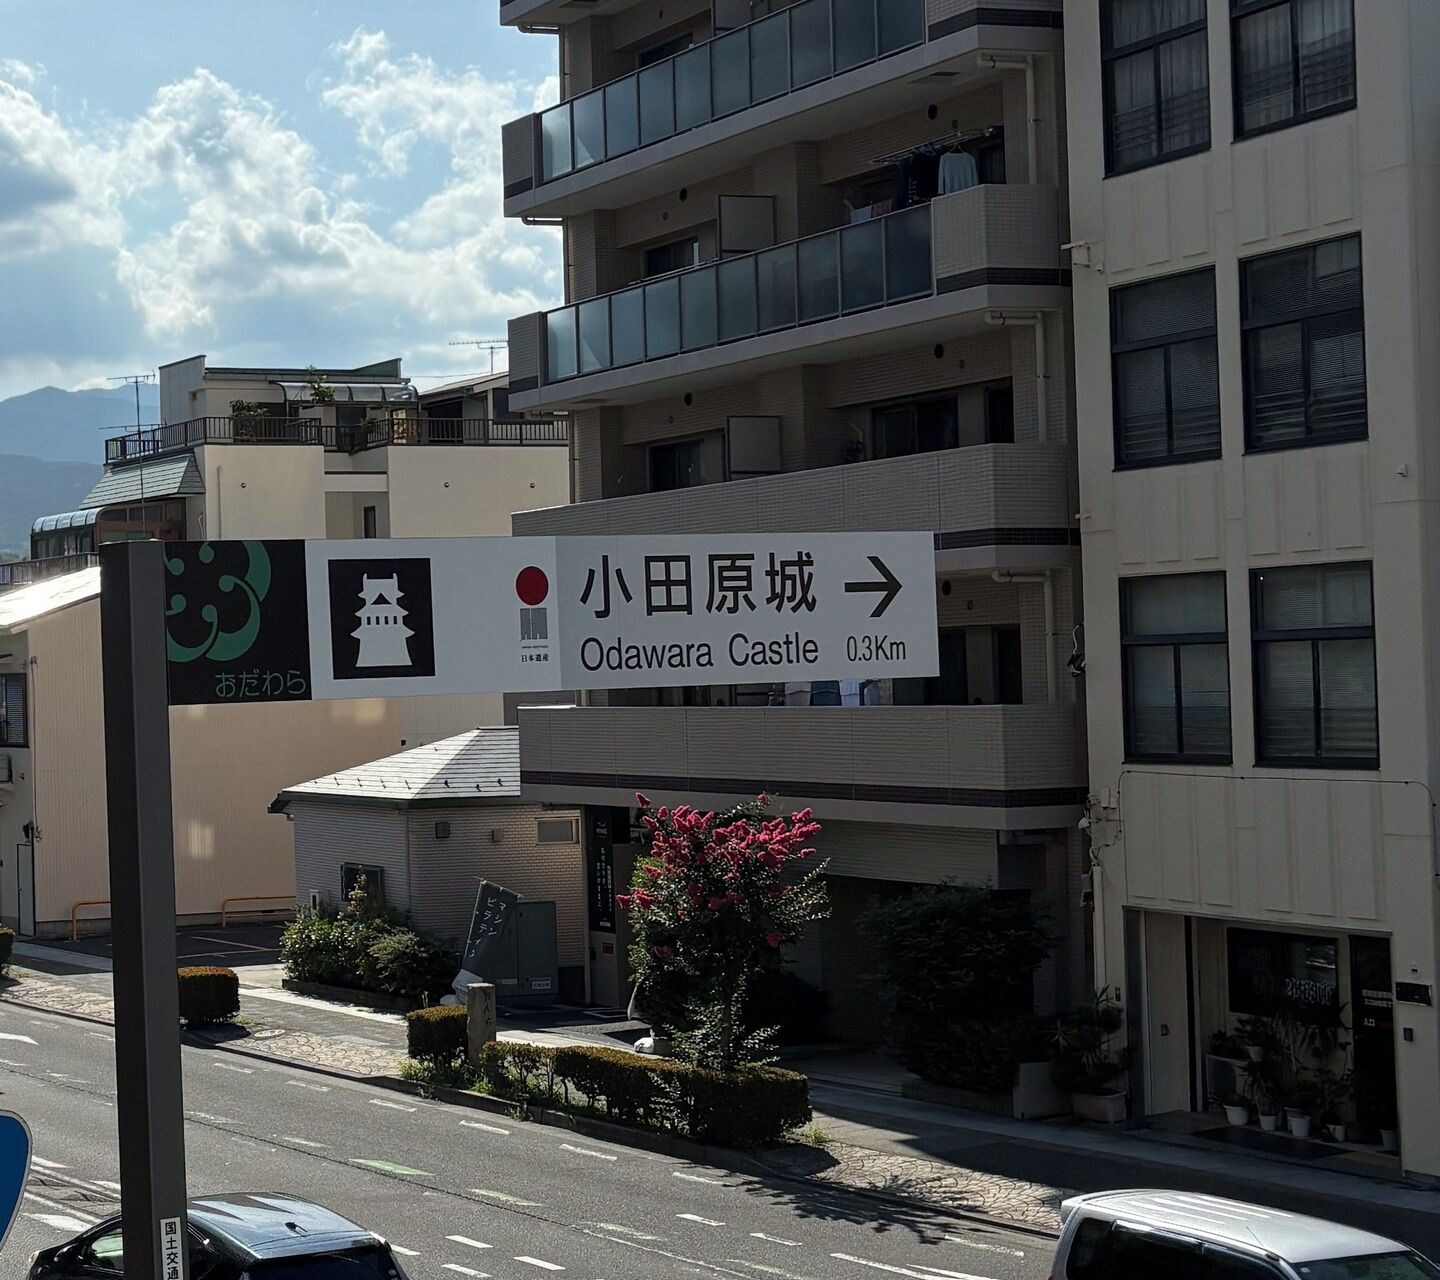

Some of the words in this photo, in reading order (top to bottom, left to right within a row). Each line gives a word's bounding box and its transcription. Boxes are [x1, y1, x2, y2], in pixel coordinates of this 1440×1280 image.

[579, 551, 817, 619] 小田原城
[580, 637, 714, 670] Odawara
[728, 632, 819, 666] Castle
[846, 635, 906, 663] 0.3Km
[214, 669, 307, 697] おだわら
